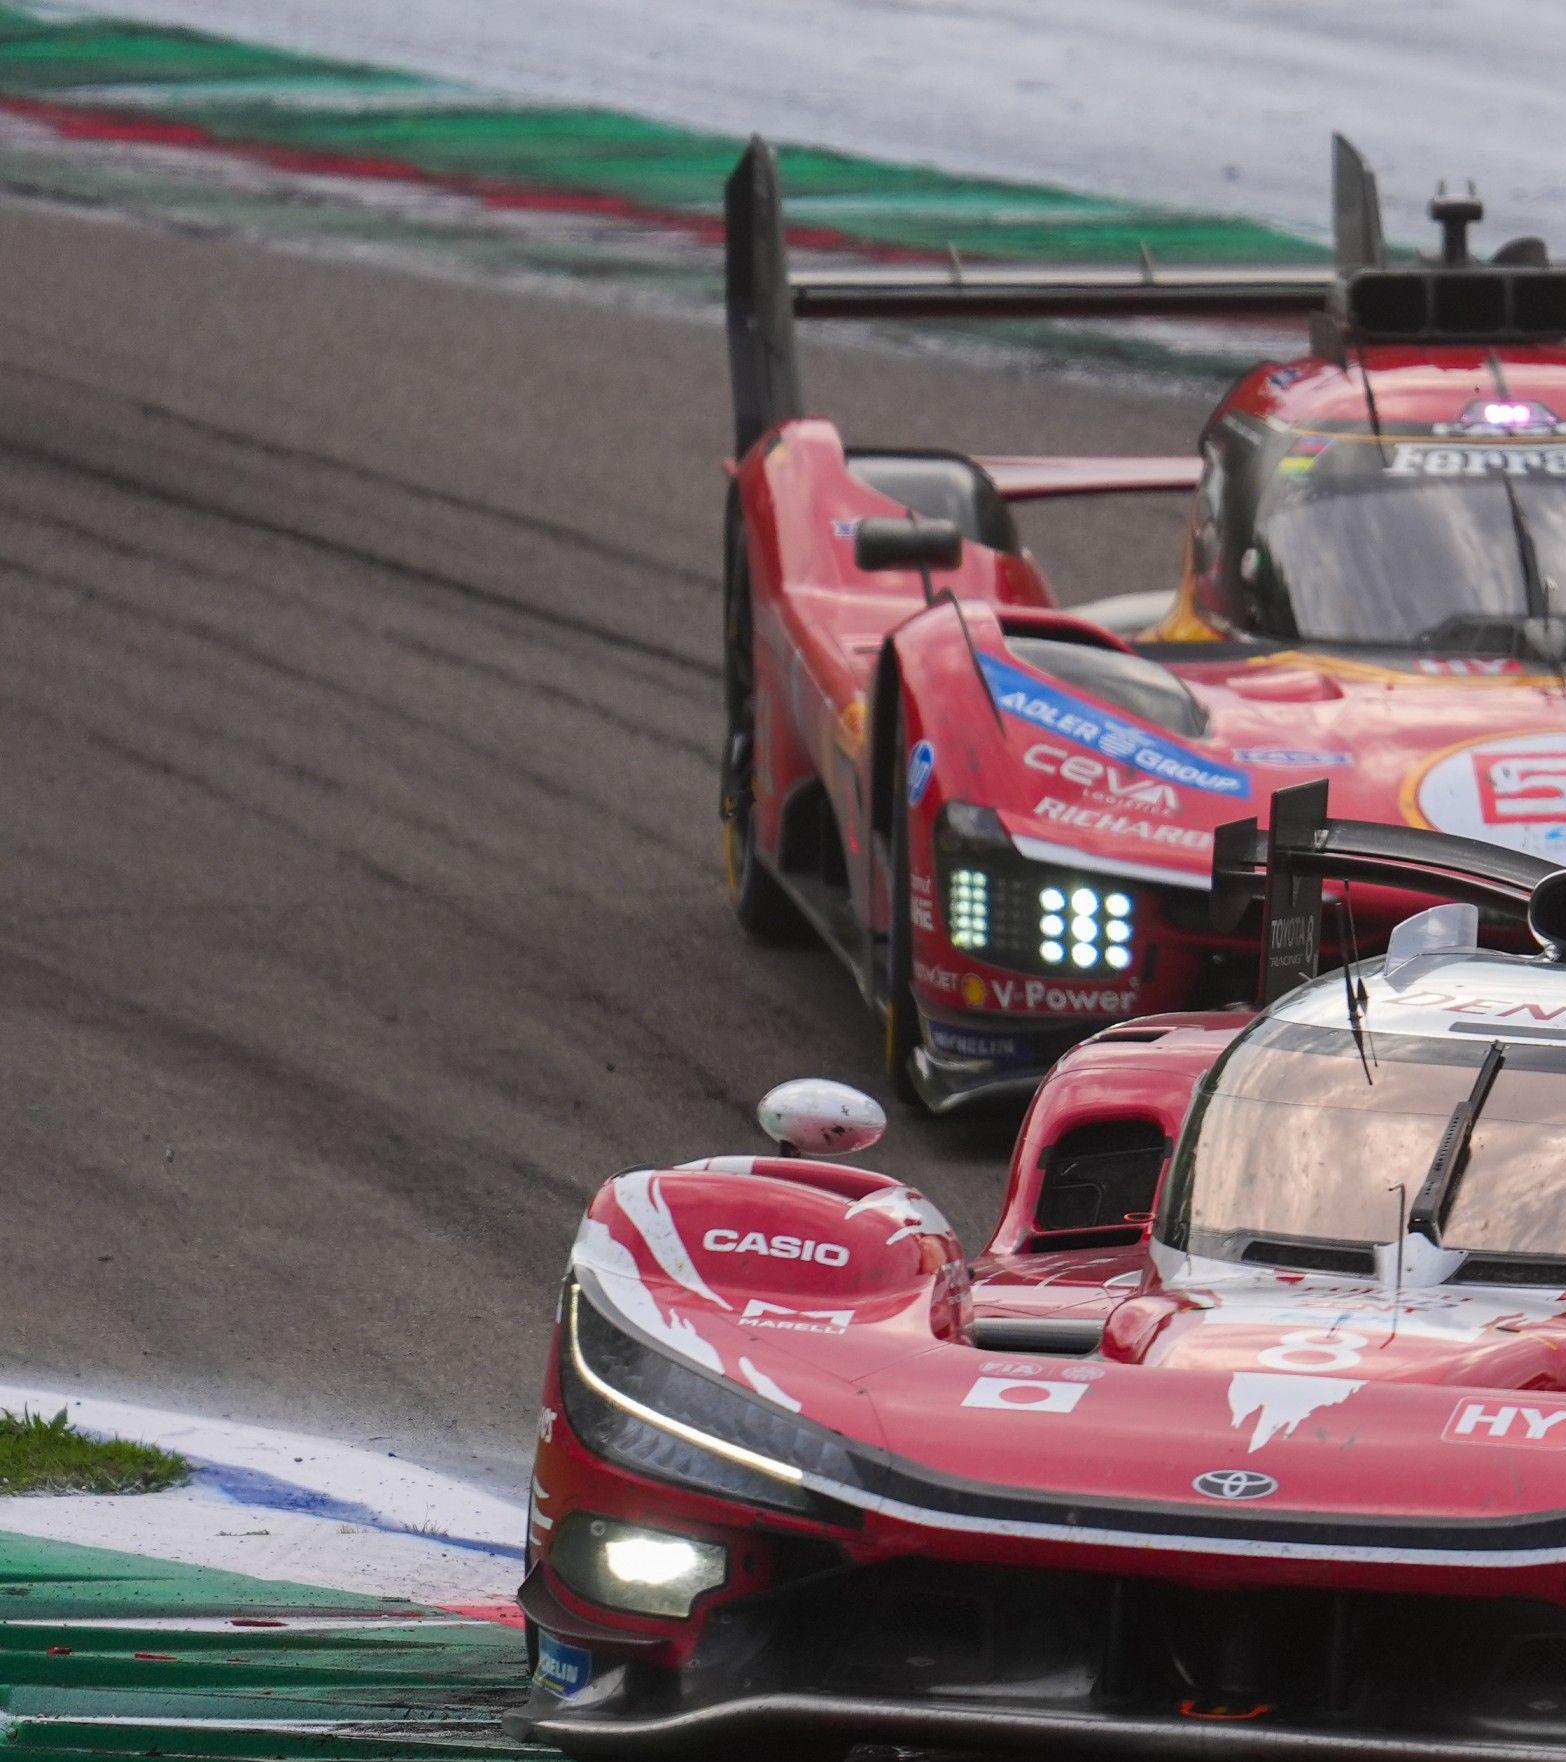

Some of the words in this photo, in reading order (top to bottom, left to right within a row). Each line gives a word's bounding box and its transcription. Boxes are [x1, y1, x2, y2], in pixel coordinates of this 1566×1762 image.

[998, 692, 1099, 741] ADLER
[1134, 749, 1242, 790] GROUP
[1271, 916, 1306, 949] TOYOTA
[1305, 914, 1315, 964] 8
[991, 979, 1136, 1012] V-Power
[702, 1228, 851, 1268] CASIO
[738, 1318, 847, 1336] MARELLI
[1257, 1330, 1369, 1372] 8
